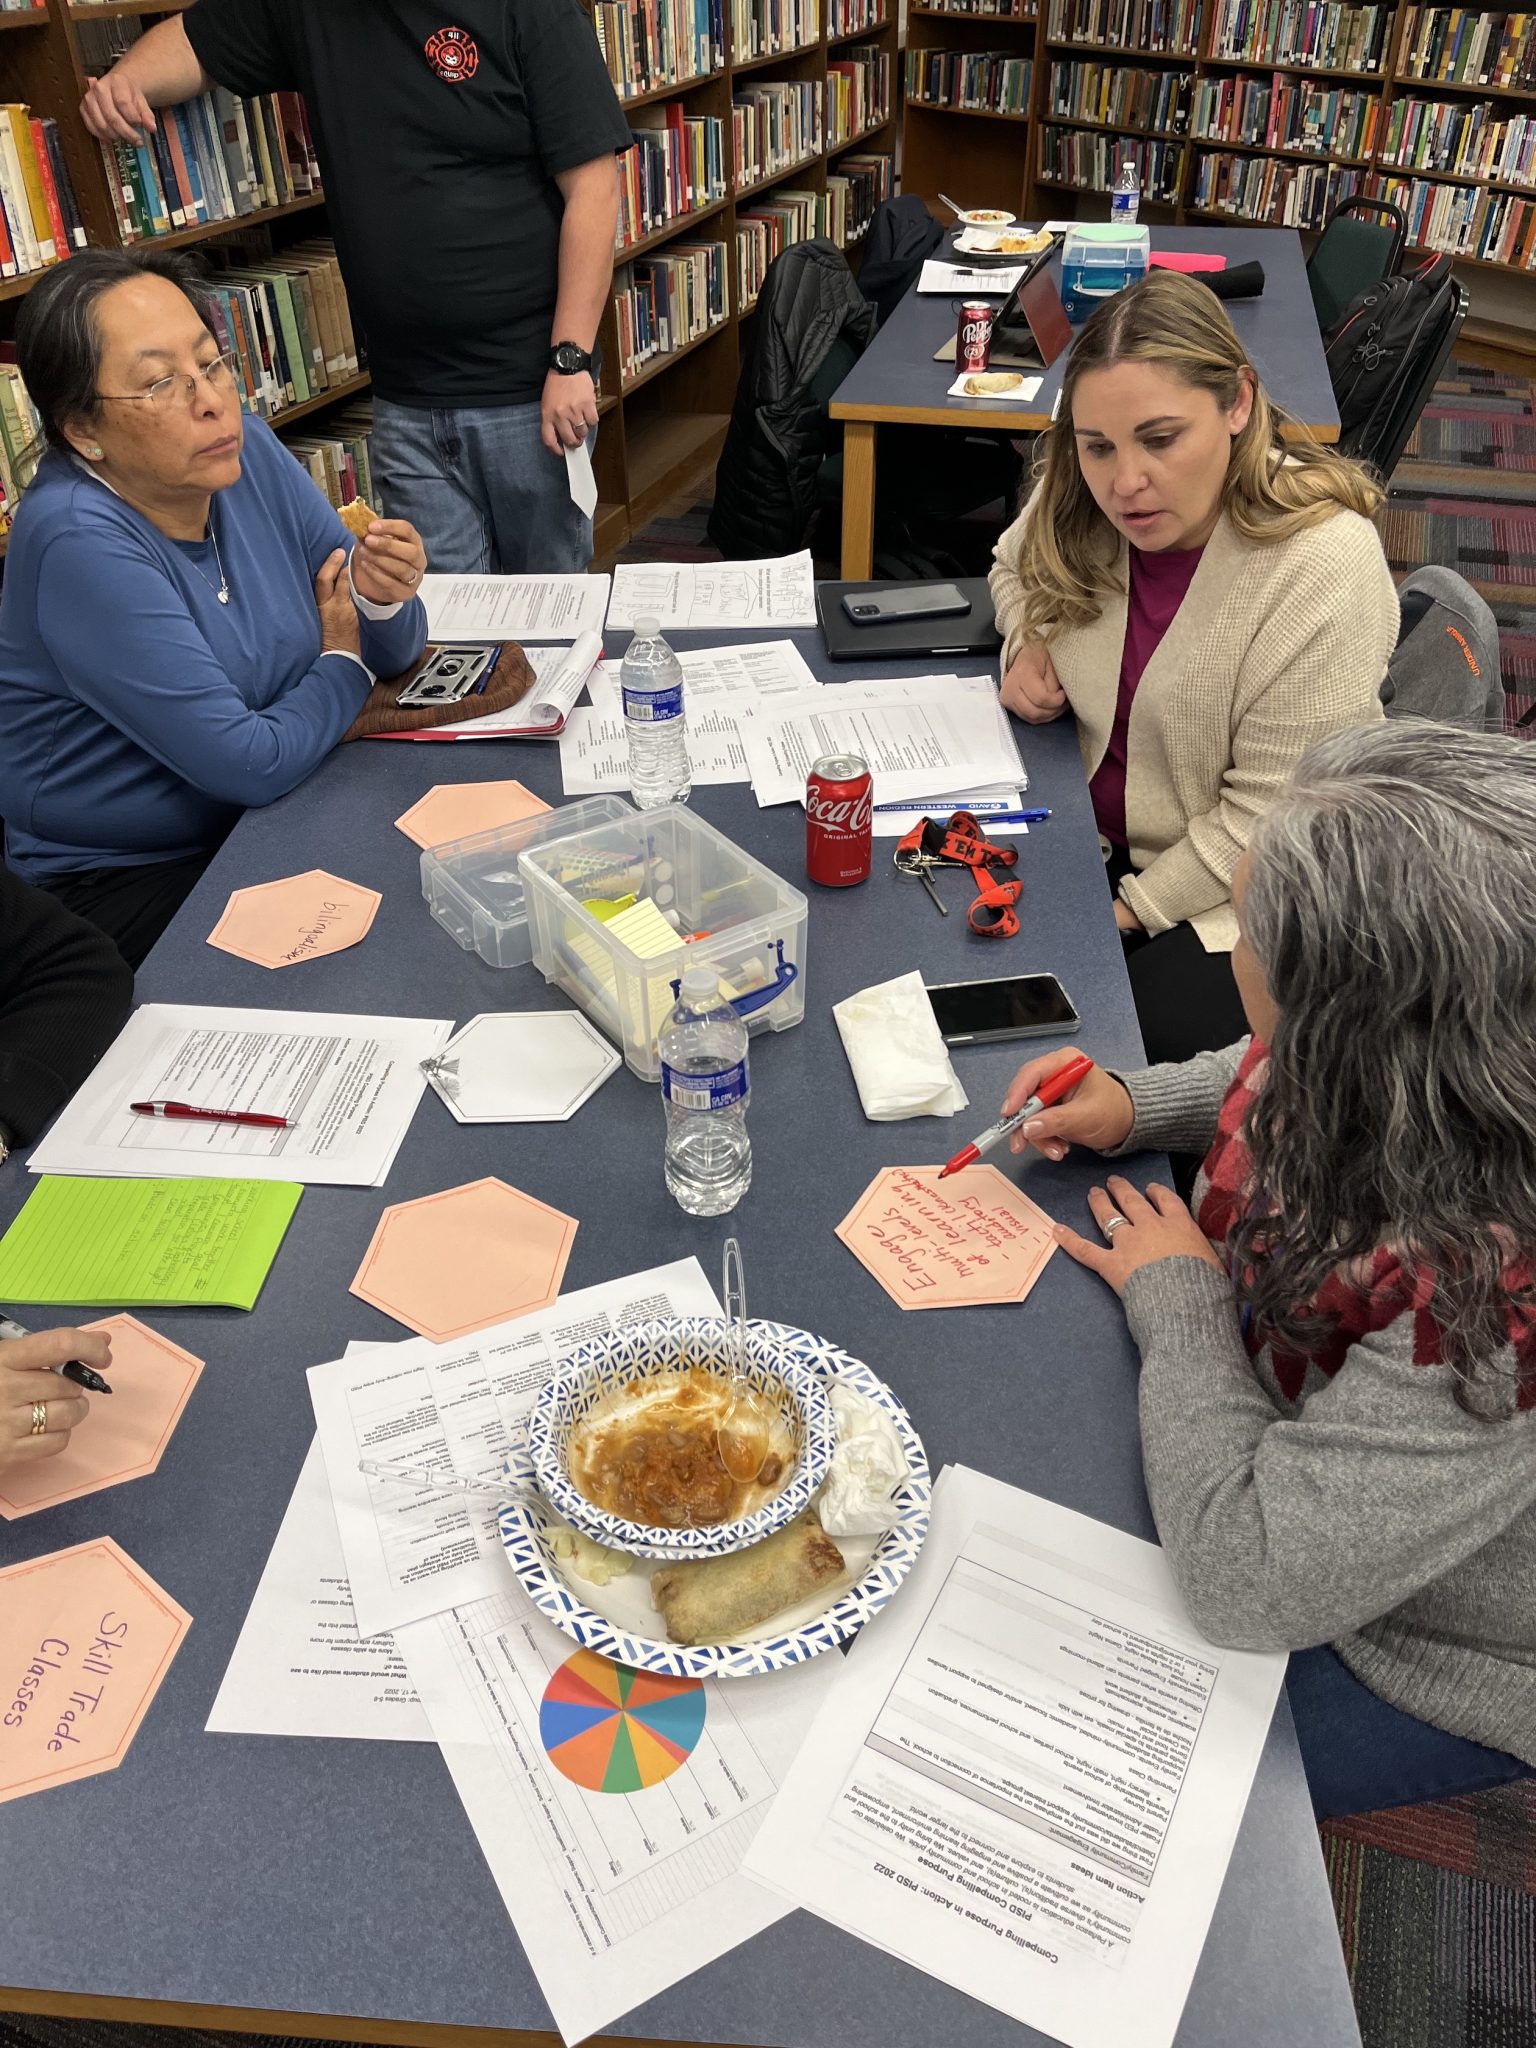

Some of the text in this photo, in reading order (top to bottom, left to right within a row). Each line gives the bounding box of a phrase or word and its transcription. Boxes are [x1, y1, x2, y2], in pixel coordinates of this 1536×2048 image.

[976, 320, 989, 332] Dr
[890, 1182, 990, 1266] of learning
[957, 1196, 1016, 1240] auditory
[866, 1223, 936, 1291] Engage
[4, 1637, 70, 1728] Classes
[47, 1610, 128, 1753] Skill Trade
[842, 1793, 857, 1804] and
[849, 1785, 891, 1810] empowering
[850, 1809, 863, 1817] our
[855, 1800, 879, 1815] school
[878, 1811, 891, 1821] the
[907, 1805, 928, 1819] world.
[862, 1815, 894, 1834] celebrate
[888, 1805, 934, 1832] environment,
[897, 1820, 916, 1834] unity
[927, 1814, 949, 1829] larger
[893, 1831, 906, 1840] We
[914, 1829, 934, 1843] bring
[931, 1827, 961, 1846] learning
[947, 1826, 961, 1836] the
[906, 1836, 927, 1851] pride.
[932, 1839, 946, 1849] We
[959, 1841, 993, 1862] engaging
[967, 1836, 996, 1854] connect
[925, 1846, 964, 1870] community
[944, 1846, 971, 1862] values.
[994, 1850, 1010, 1861] and
[962, 1866, 978, 1877] and
[969, 1858, 985, 1870] and
[991, 1858, 1007, 1870] and
[1009, 1856, 1037, 1874] explore
[976, 1874, 1001, 1889] school
[984, 1865, 1020, 1888] culture(s),
[1005, 1864, 1034, 1884] positive
[1035, 1870, 1045, 1878] to
[1069, 1862, 1144, 1904] Action Item Ideas
[916, 1854, 1032, 1921] PISD Compelling Purpose
[1039, 1883, 1070, 1902] cultivate
[1043, 1874, 1075, 1894] students
[1008, 1890, 1032, 1906] rooted
[1018, 1882, 1060, 1908] tradition(s),
[1069, 1898, 1082, 1907] we
[872, 1862, 1059, 1964] Compelling Purpose in Action: PISD 2022
[1038, 1906, 1075, 1928] education
[1058, 1904, 1086, 1922] diverse
[1090, 1908, 1132, 1933] community
[1074, 1924, 1107, 1944] Peñasco
[1084, 1916, 1132, 1945] community's
